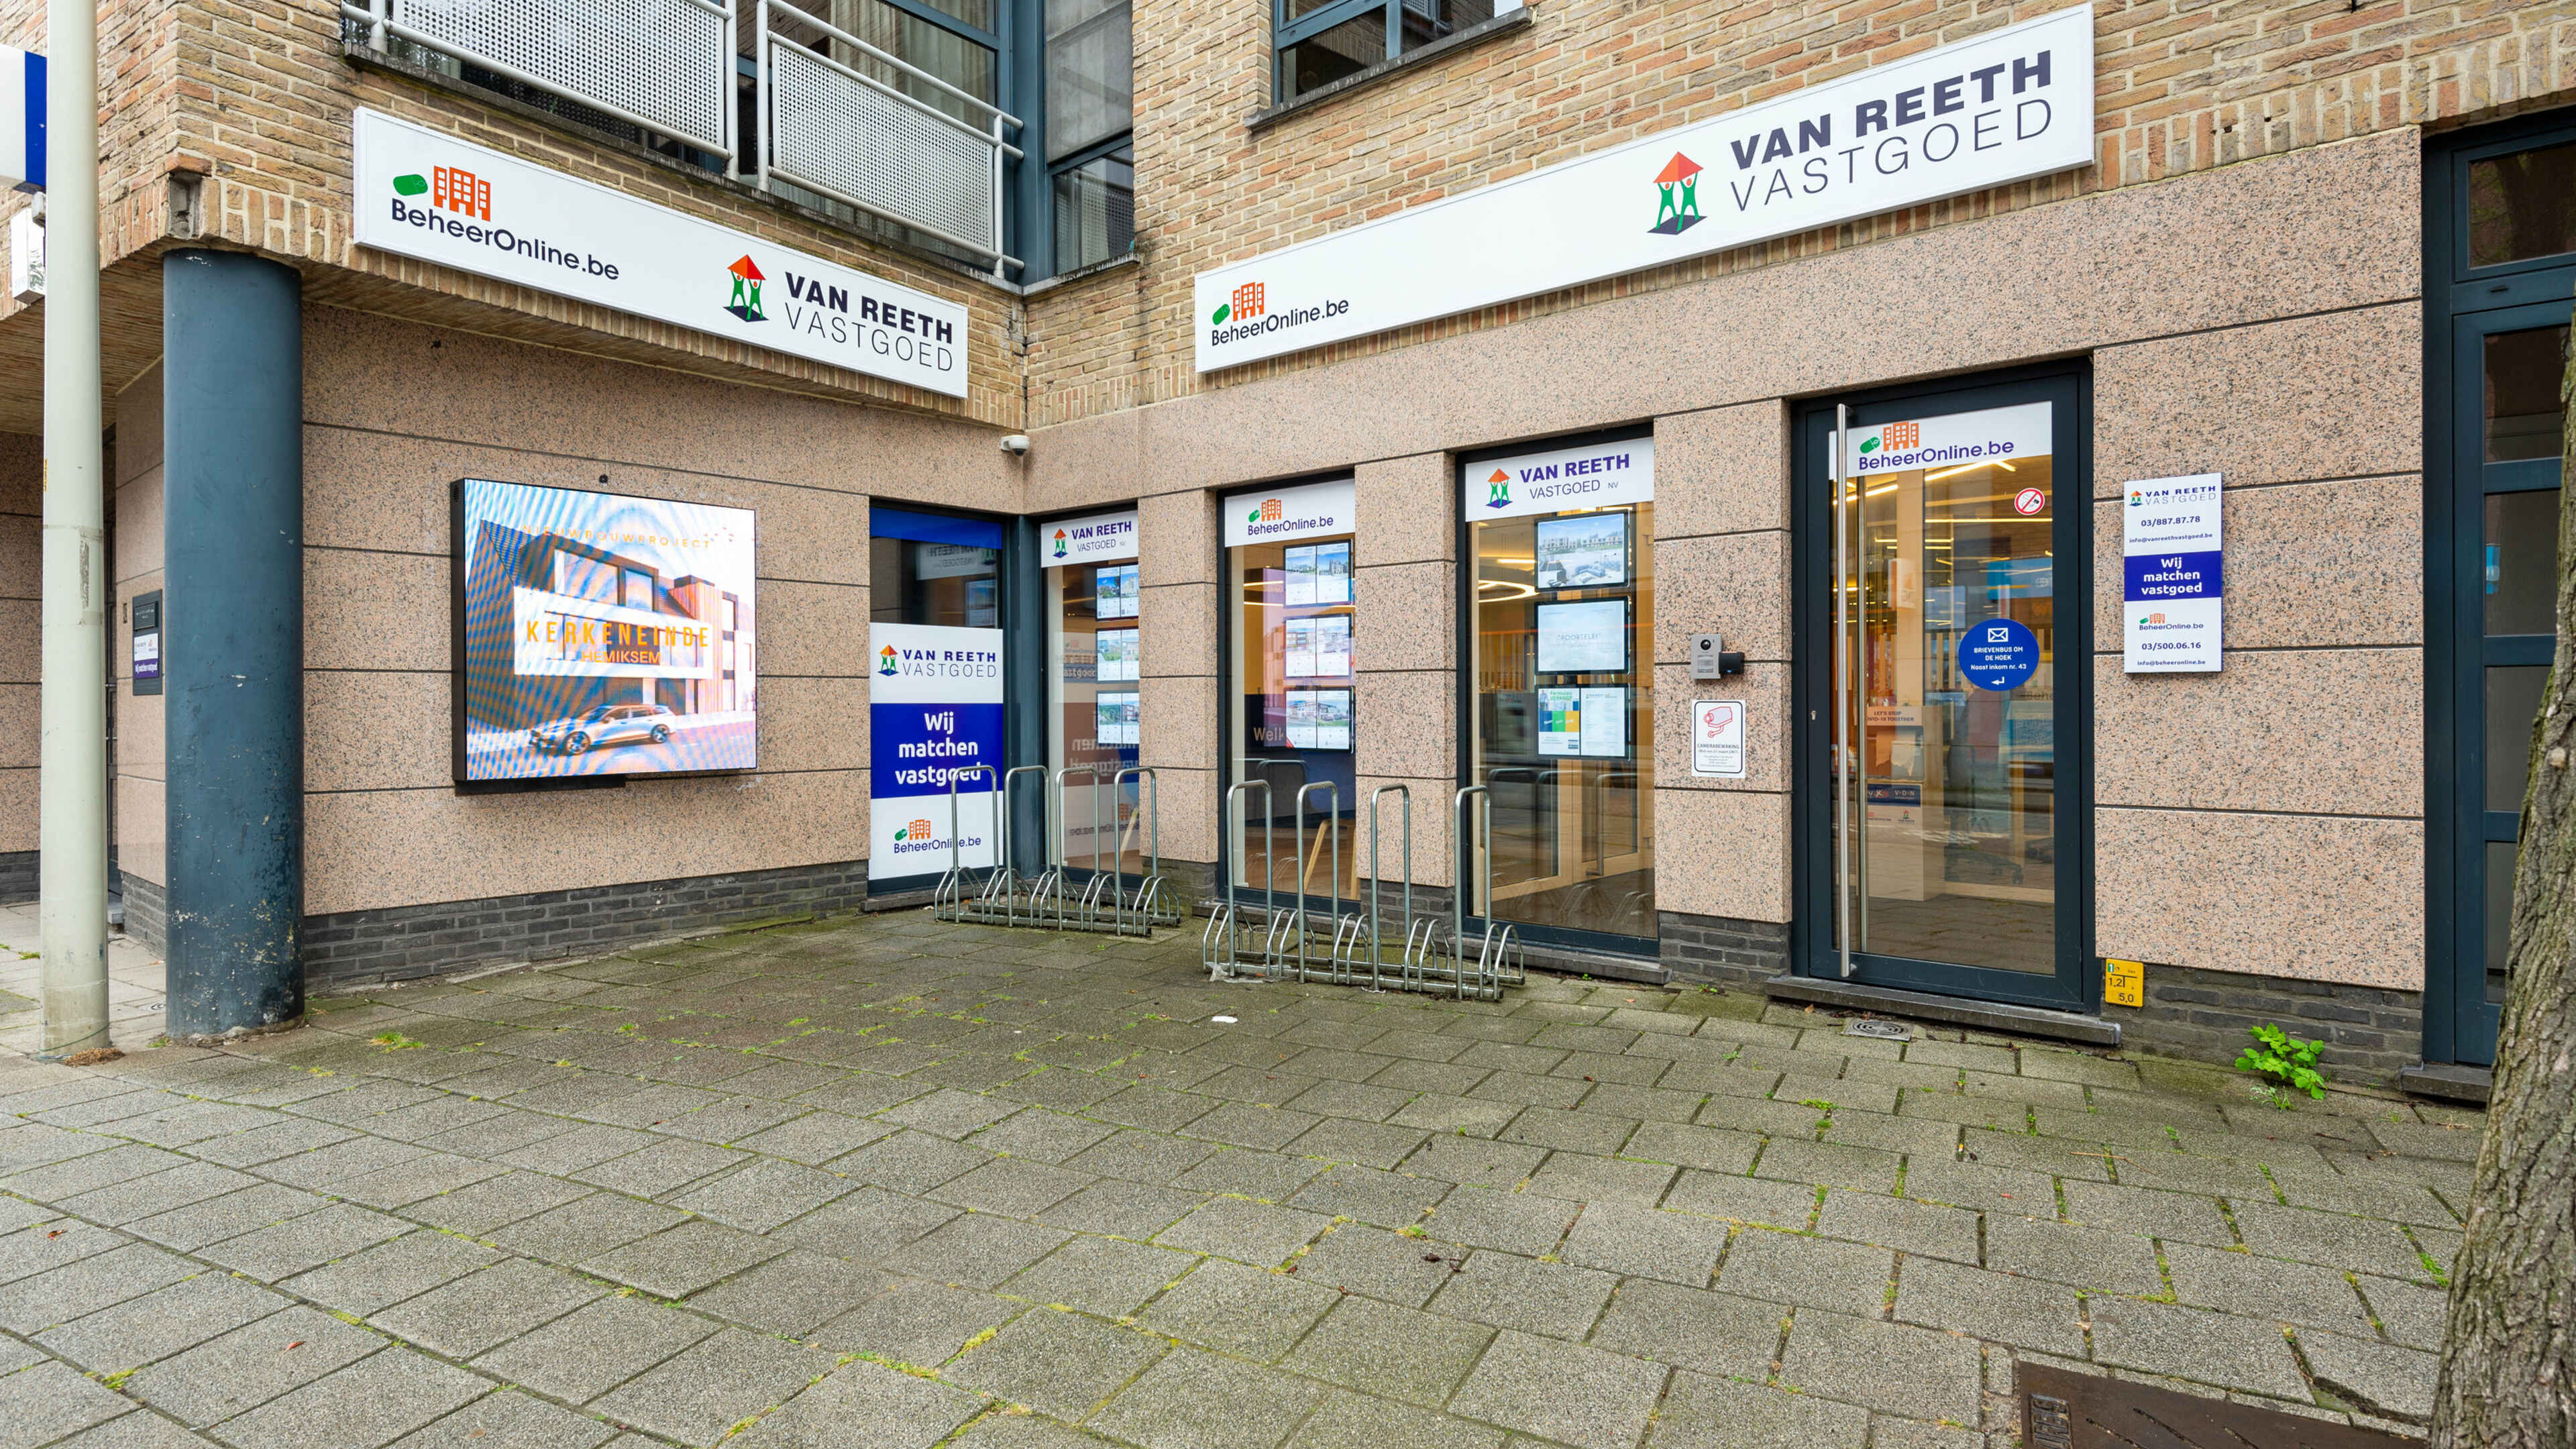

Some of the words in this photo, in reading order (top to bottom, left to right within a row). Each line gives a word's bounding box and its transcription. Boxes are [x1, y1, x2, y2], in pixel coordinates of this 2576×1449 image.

[1730, 113, 1831, 170] VAN
[1856, 49, 2051, 138] REETH
[1730, 99, 2051, 212] VASTGOED
[392, 198, 619, 280] BeheerOnline.be
[785, 271, 848, 313] VAN
[861, 295, 953, 344] REETH
[1212, 299, 1349, 346] BeheerOnline.be
[785, 302, 953, 372] VASTGOED
[1859, 441, 2014, 470] BeheerOnline.be
[1519, 464, 1558, 483] VAN
[1565, 453, 1630, 478] REETH
[1529, 479, 1601, 500] VASTGOED
[1607, 481, 1619, 489] NV
[2145, 492, 2216, 505] VASTGOED
[2176, 486, 2216, 495] REETH
[1071, 527, 1093, 540] VAN
[1096, 521, 1132, 537] REETH
[1248, 516, 1334, 535] BeheerOnline.be
[2141, 515, 2200, 527] 03/887.87.78
[523, 525, 710, 548] NIEUWBOUWPROJECT
[1077, 539, 1116, 552] VASTGOED
[2129, 533, 2213, 543] info@vanreethvastgoed.be
[2161, 557, 2182, 569] Wij
[2143, 570, 2200, 582] matchen
[2141, 582, 2202, 596] vastgoed
[527, 620, 708, 647] KERKENEINDE
[2139, 623, 2204, 631] BeheerOnline.be
[902, 649, 936, 661] VAN
[944, 650, 996, 662] REETH
[2141, 642, 2202, 651] 03/500.06.16
[581, 650, 661, 664] HEMIKSEM
[902, 662, 997, 678] VASTGOED
[924, 712, 955, 735] Wij
[898, 737, 979, 758] matchen
[894, 762, 981, 787] vastgoed
[894, 837, 981, 854] BeheerOnlie.be
[2118, 992, 2135, 1003] 5.0
